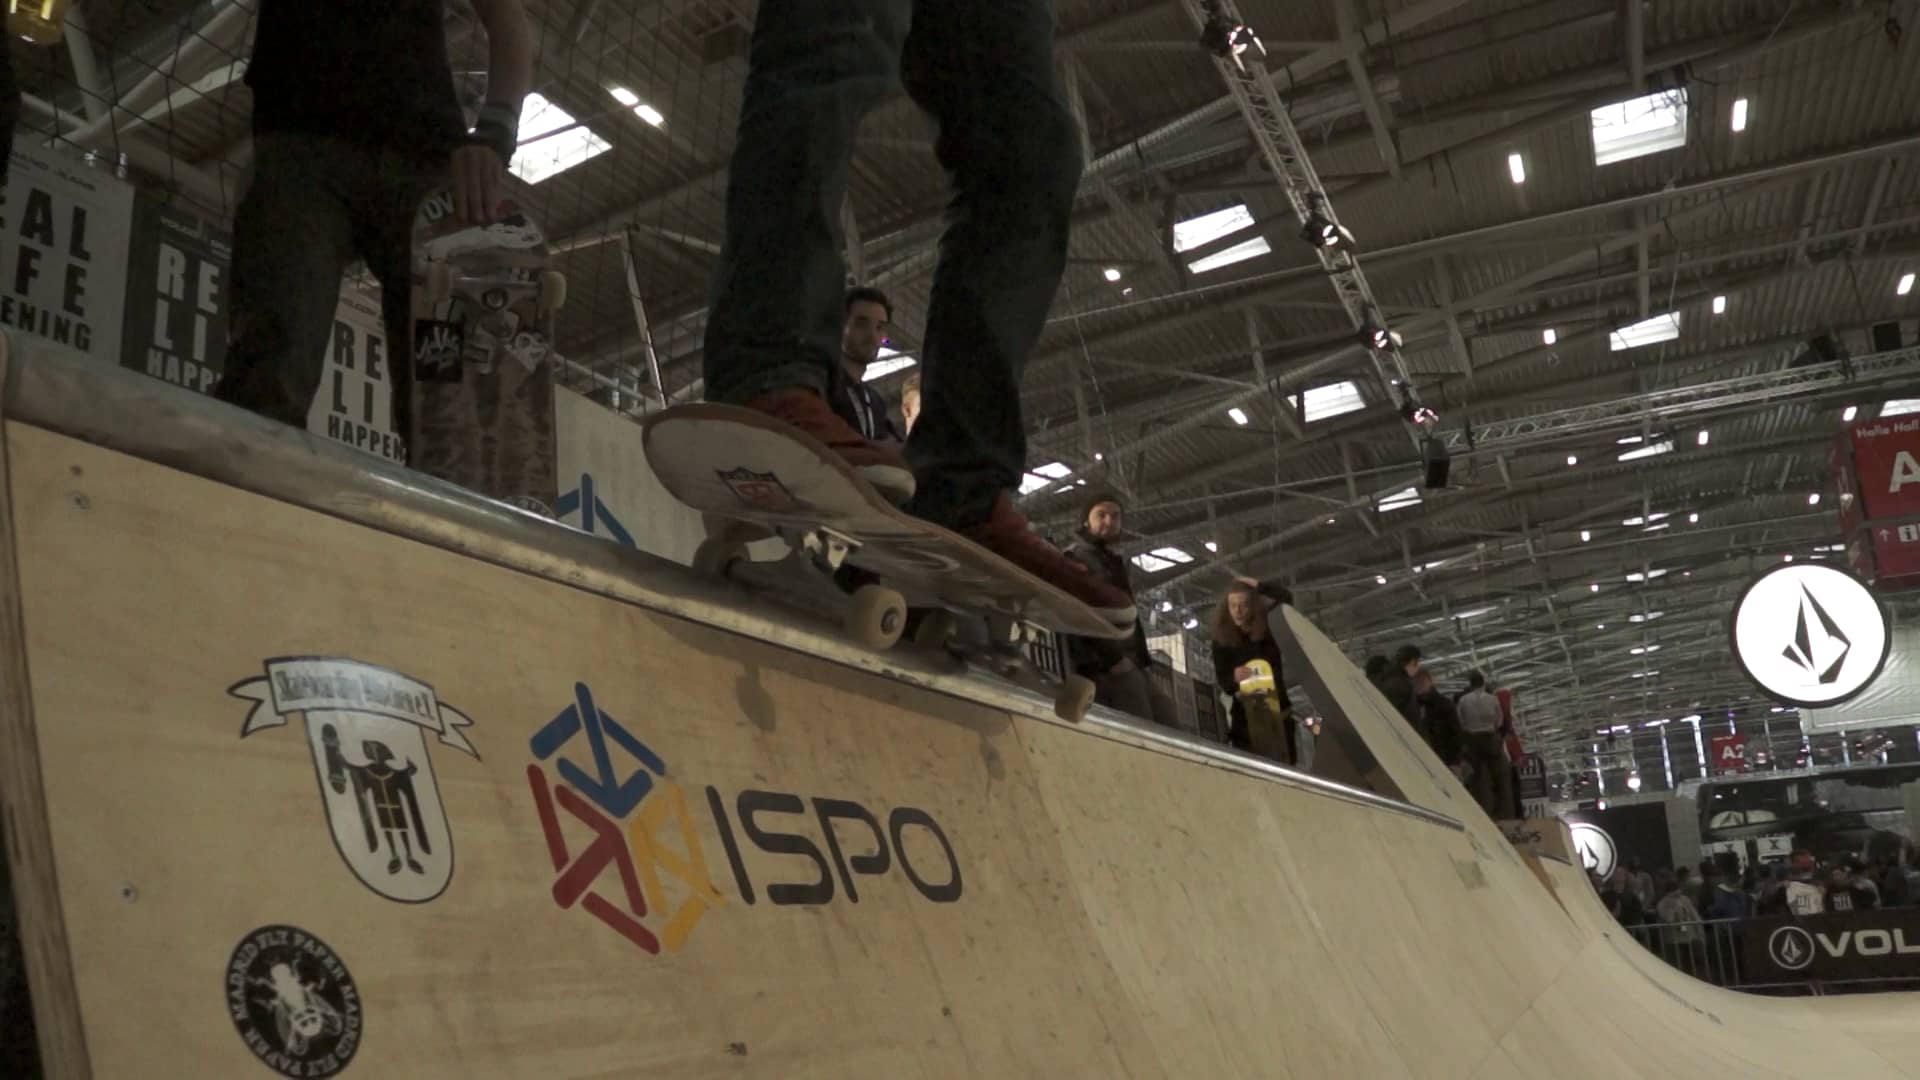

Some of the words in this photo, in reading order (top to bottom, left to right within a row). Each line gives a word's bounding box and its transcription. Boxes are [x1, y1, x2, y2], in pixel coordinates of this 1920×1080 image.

[0, 187, 91, 262] AL
[705, 784, 963, 906] ISPO
[1814, 928, 1920, 958] VOL
